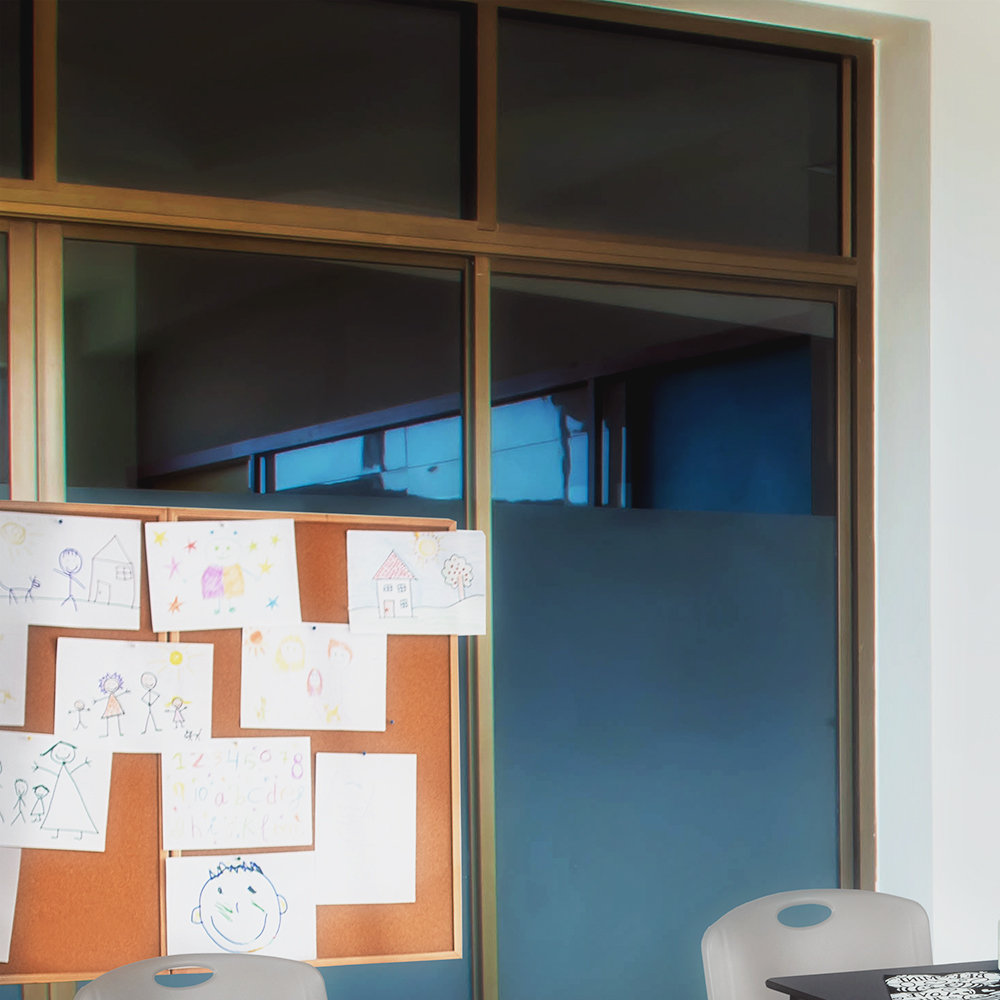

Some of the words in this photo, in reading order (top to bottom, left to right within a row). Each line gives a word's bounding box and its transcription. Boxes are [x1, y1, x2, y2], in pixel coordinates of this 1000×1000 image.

[172, 752, 187, 770] 1
[190, 752, 205, 768] 2
[227, 749, 240, 770] 4
[291, 752, 304, 779] 8
[194, 786, 208, 802] 10
[214, 791, 228, 807] a
[266, 783, 277, 805] d
